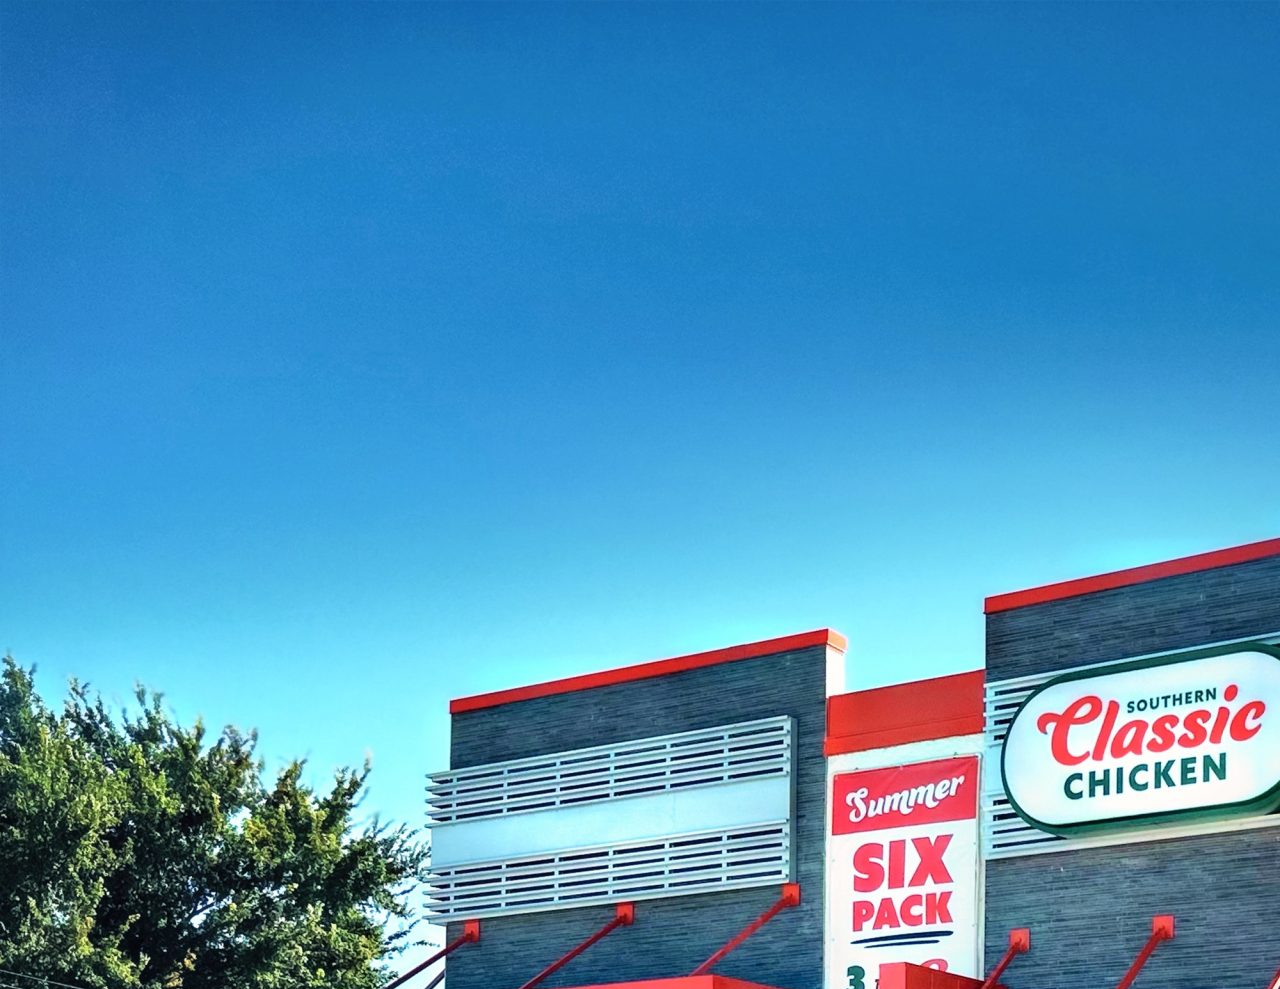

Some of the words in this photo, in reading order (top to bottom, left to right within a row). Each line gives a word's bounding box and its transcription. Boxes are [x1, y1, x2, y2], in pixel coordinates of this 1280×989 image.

[1127, 687, 1217, 714] SOUTHERN
[1036, 684, 1266, 766] Classic
[845, 774, 965, 823] Summer
[1063, 752, 1227, 800] CHICKEN
[852, 834, 954, 893] SIX
[852, 891, 953, 932] PACK
